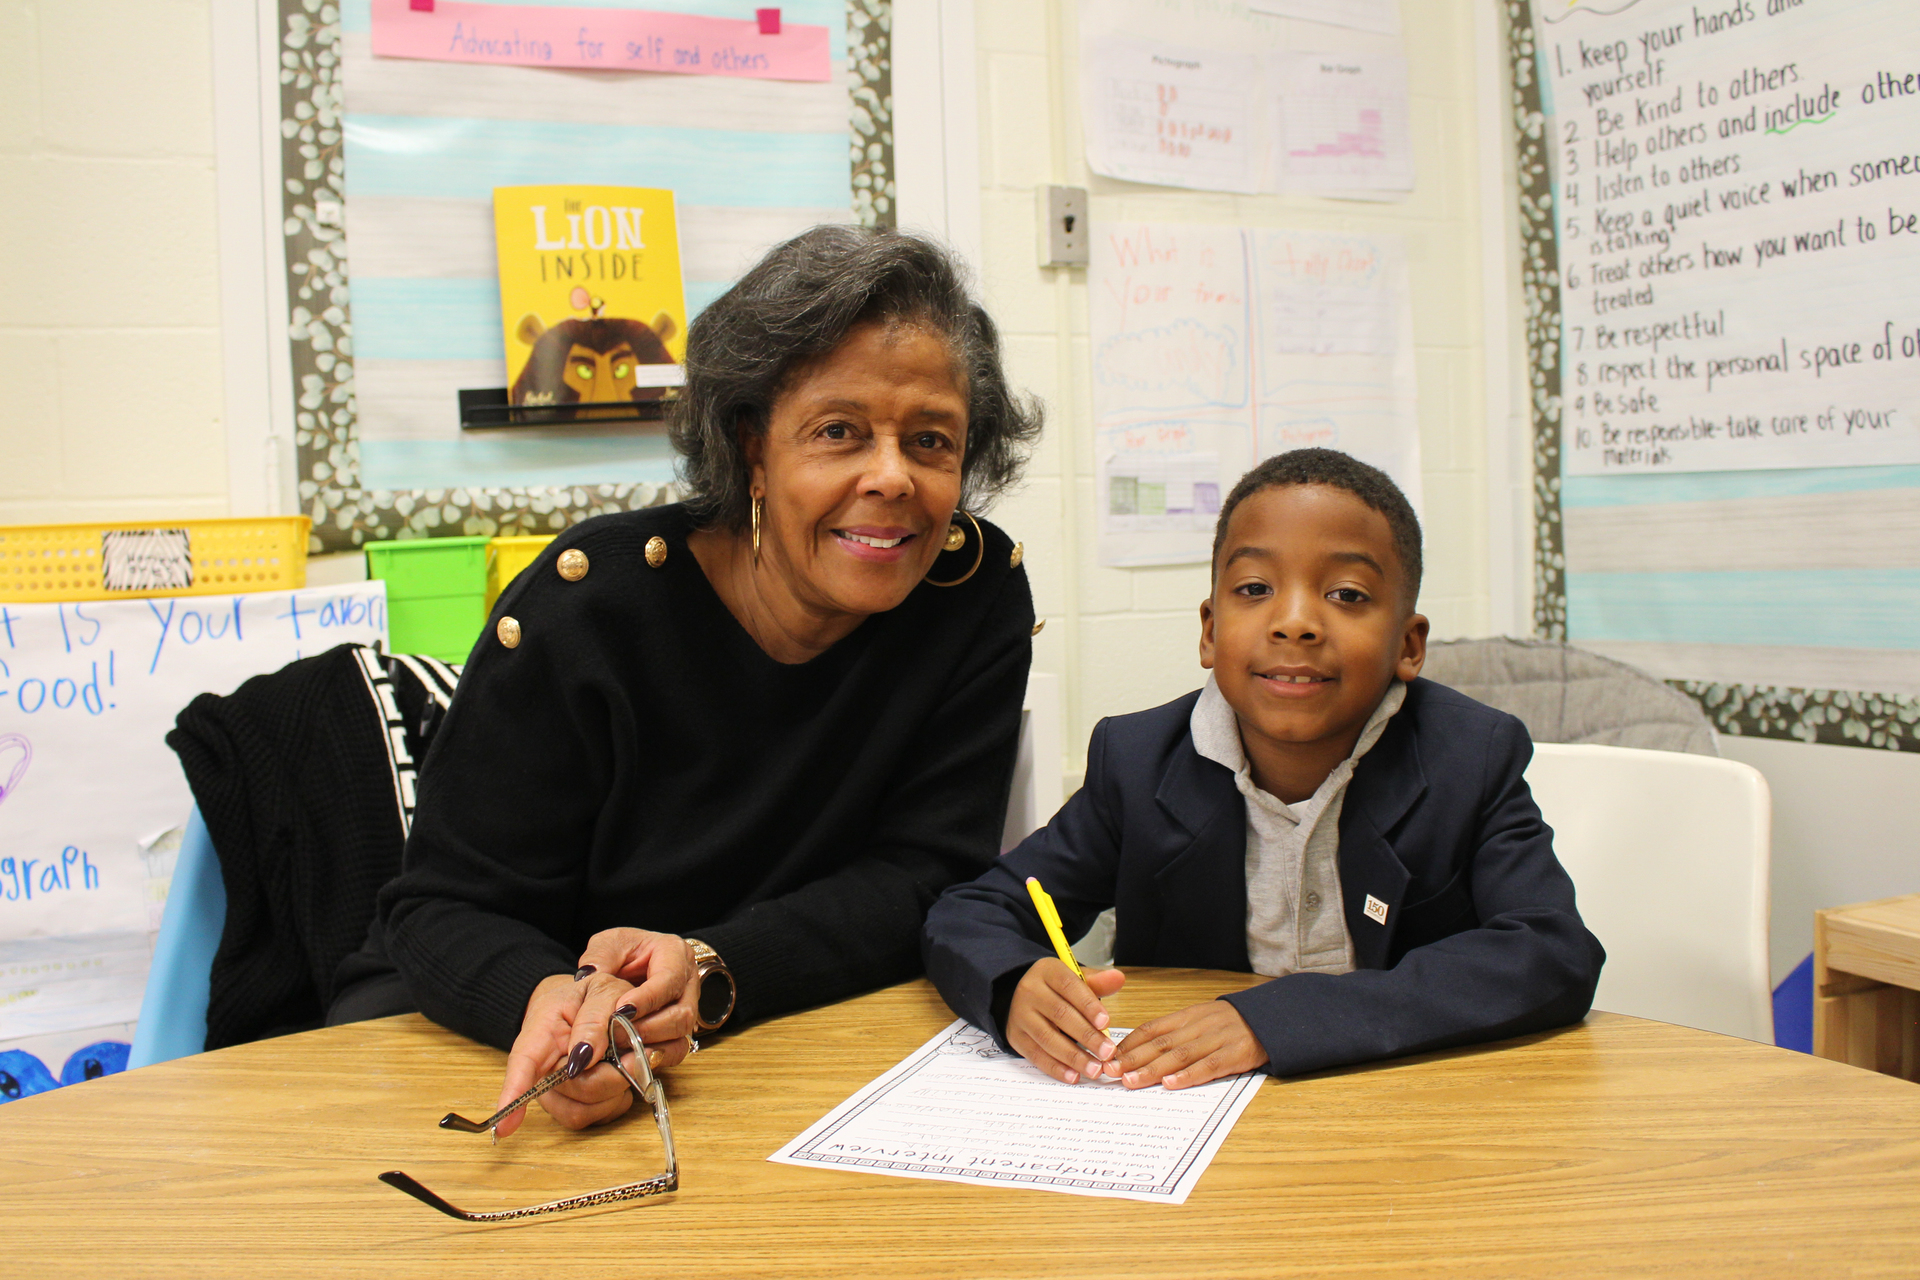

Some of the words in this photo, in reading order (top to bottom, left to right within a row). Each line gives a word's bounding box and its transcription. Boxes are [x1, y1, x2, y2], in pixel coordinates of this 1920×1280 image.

[448, 21, 552, 62] Advocating
[577, 27, 604, 61] for
[625, 36, 664, 64] self
[674, 43, 700, 66] and
[711, 46, 770, 71] others
[1557, 44, 1571, 77] 1.
[1579, 40, 1628, 72] keep
[1640, 24, 1683, 64] your
[1692, 0, 1755, 37] hands
[1582, 59, 1664, 107] yourself
[1596, 108, 1623, 136] Be
[1698, 81, 1718, 108] to
[1596, 139, 1638, 171] Help
[1646, 122, 1706, 154] others
[1718, 107, 1756, 139] and
[1765, 83, 1841, 128] include
[1861, 71, 1920, 104] othe
[1651, 165, 1670, 188] to
[1679, 153, 1740, 184] others
[564, 198, 581, 213] THE
[1643, 208, 1652, 226] a
[1664, 189, 1711, 233] quiet
[1719, 181, 1771, 211] voice
[1781, 168, 1836, 199] when
[1591, 263, 1631, 285] Treat
[1640, 251, 1695, 279] others
[1703, 242, 1742, 269] how
[1755, 237, 1786, 267] you
[1794, 219, 1845, 253] want
[1858, 216, 1876, 244] to
[1889, 207, 1918, 235] be
[541, 252, 644, 282] INSIDE
[1593, 284, 1653, 316] treated
[1596, 325, 1619, 349] Be
[1623, 310, 1725, 353] respectful
[1599, 358, 1656, 387] respect
[1667, 357, 1698, 379] the
[1707, 337, 1788, 392] personal
[1801, 342, 1862, 378] space
[1873, 321, 1894, 360] of
[1594, 391, 1613, 415] Be
[1617, 387, 1659, 414] safe
[1603, 423, 1621, 446] Be
[1772, 413, 1807, 435] care
[1818, 407, 1835, 430] of
[1844, 407, 1896, 436] your
[1367, 900, 1385, 916] 150
[828, 1143, 955, 1164] Interview
[967, 1157, 1155, 1182] Grandparent
